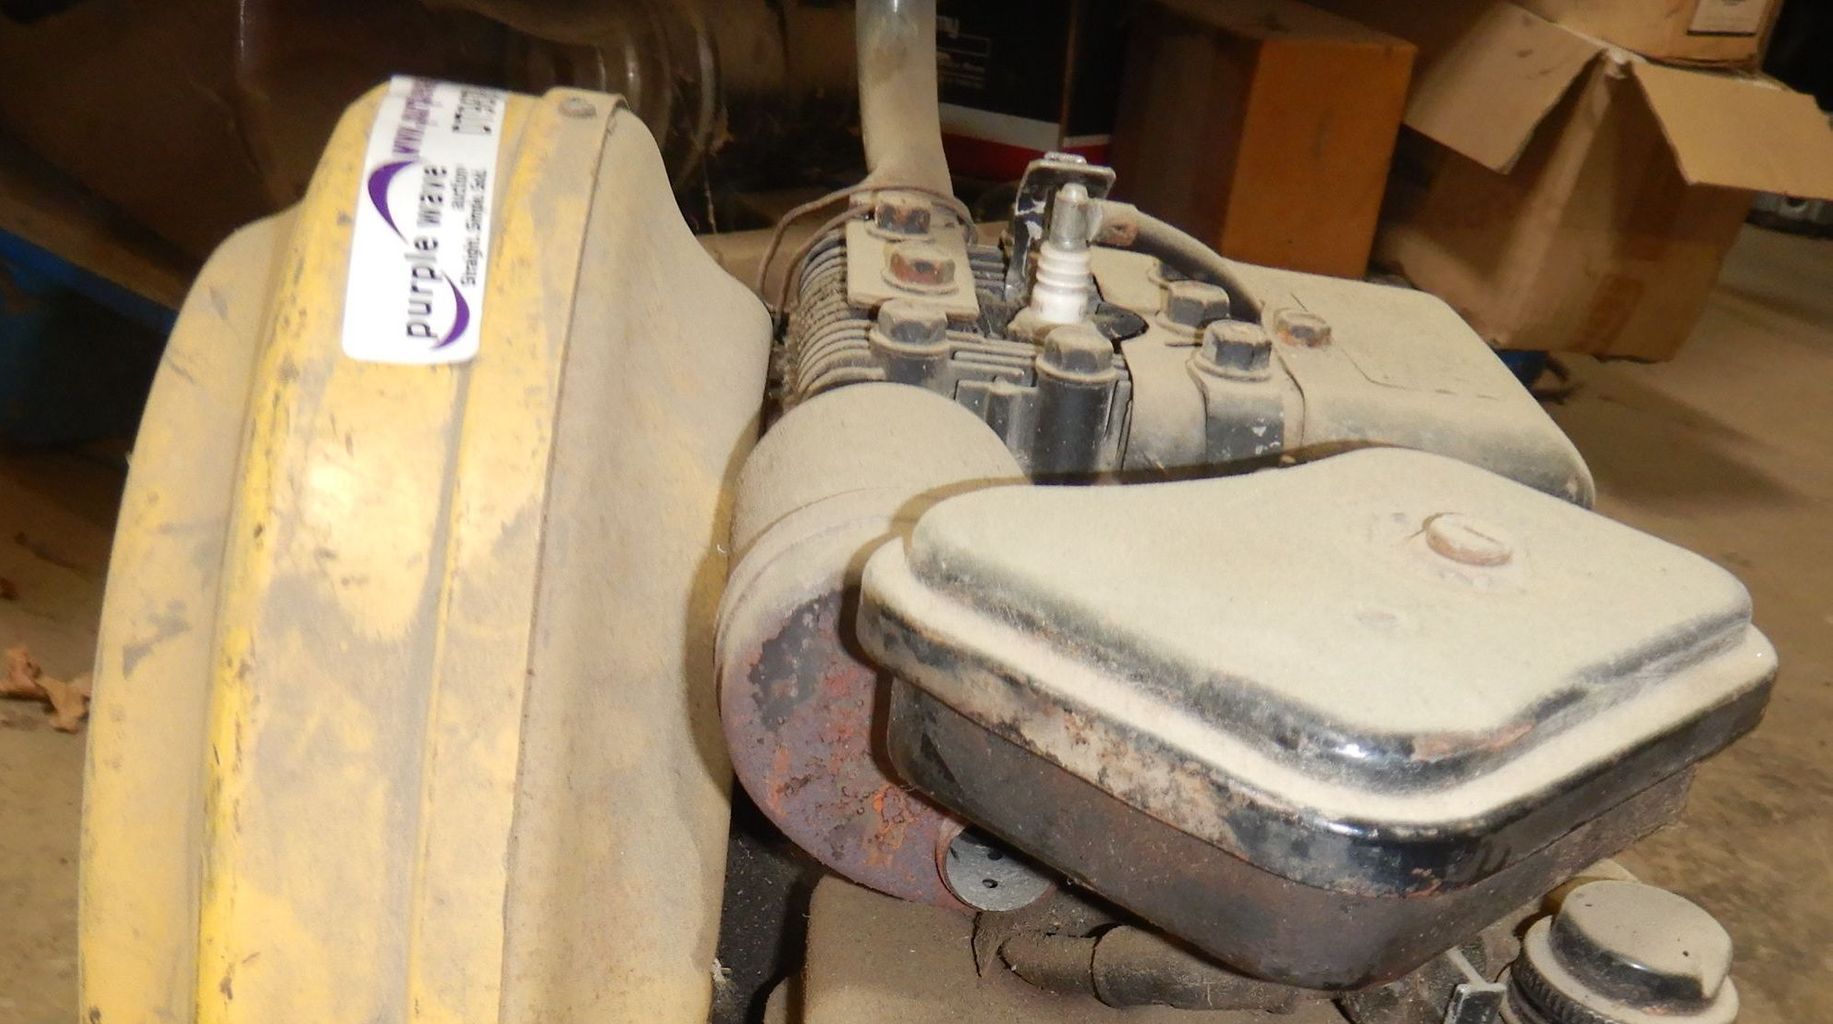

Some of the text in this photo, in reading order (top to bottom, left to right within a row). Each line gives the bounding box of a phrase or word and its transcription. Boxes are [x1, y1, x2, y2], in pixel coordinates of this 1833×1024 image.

[450, 163, 468, 212] auction
[404, 163, 448, 340] purple wave
